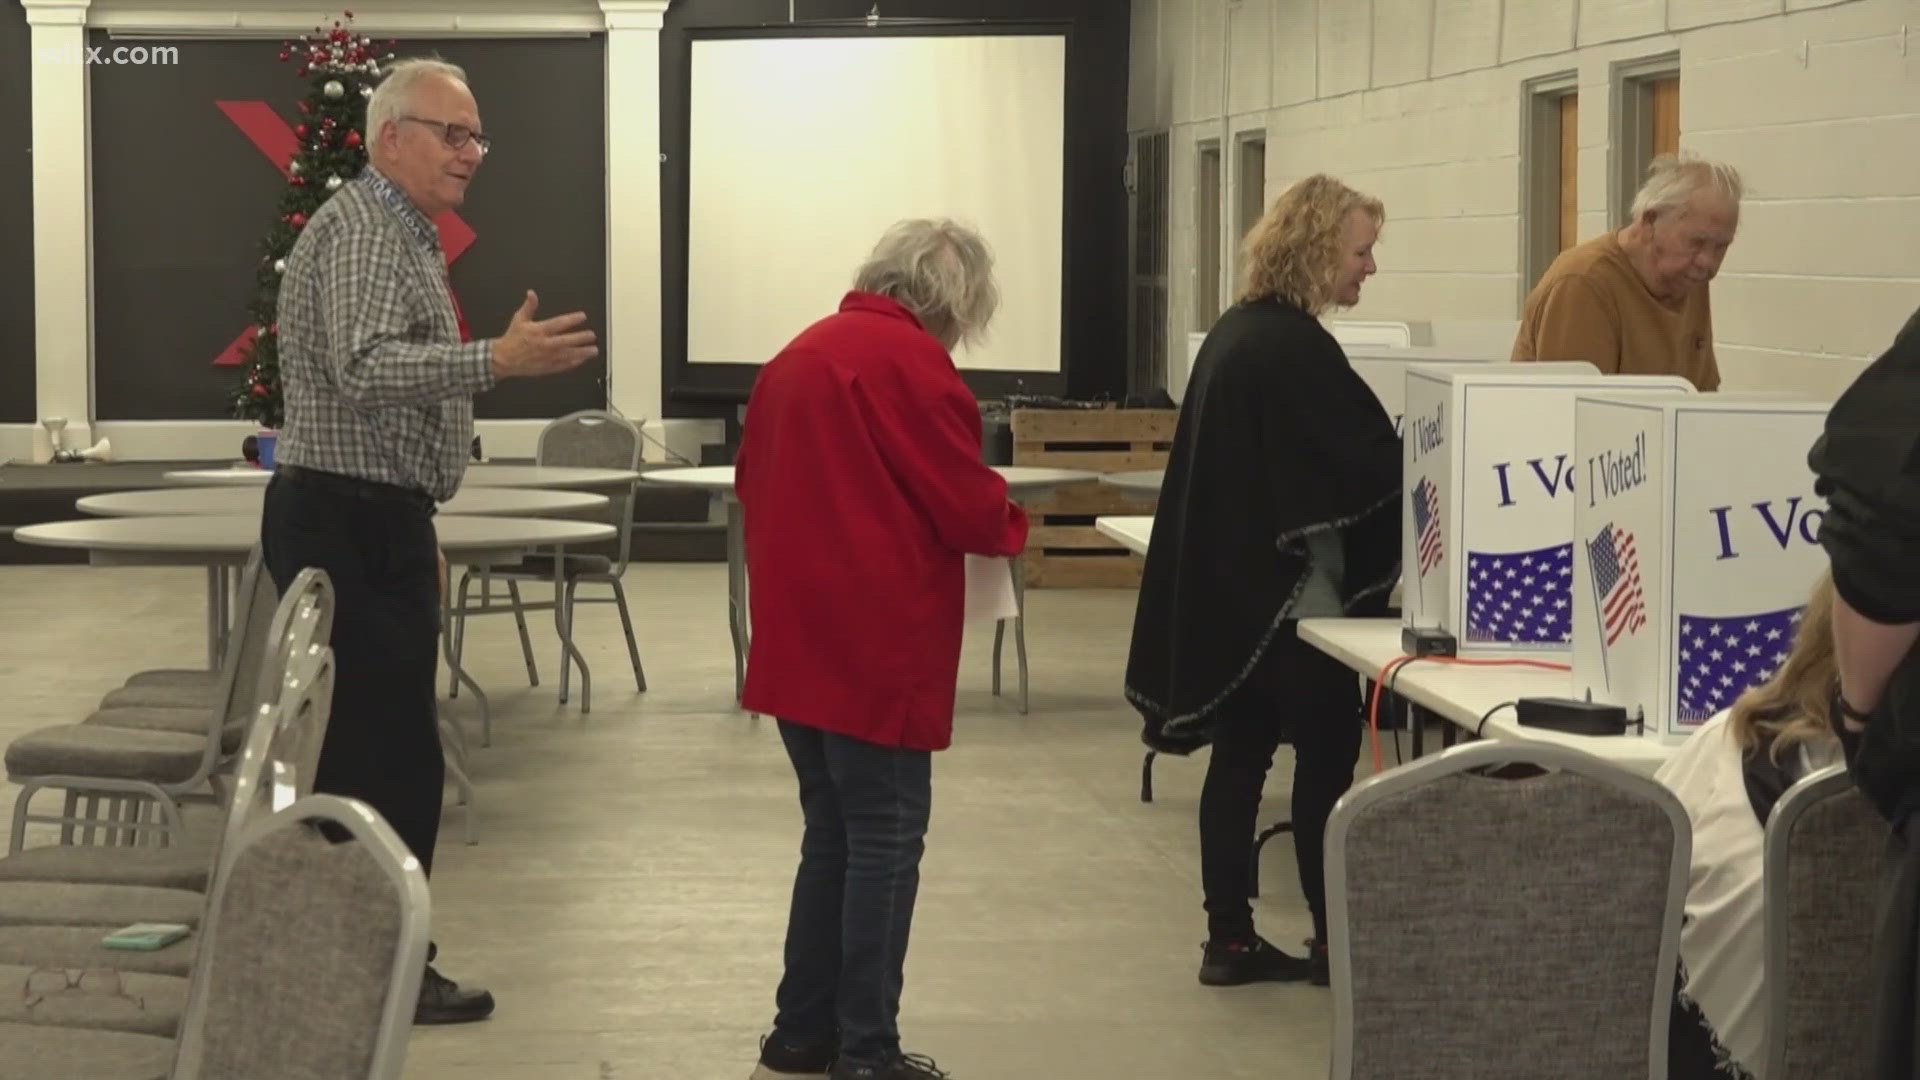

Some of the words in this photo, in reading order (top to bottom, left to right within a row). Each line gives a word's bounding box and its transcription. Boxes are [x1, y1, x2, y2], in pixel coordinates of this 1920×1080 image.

[1418, 401, 1444, 455] Voted!
[1492, 462, 1517, 508] I
[1588, 456, 1596, 508] I
[1599, 429, 1647, 500] Voted!
[1709, 505, 1740, 560] I
